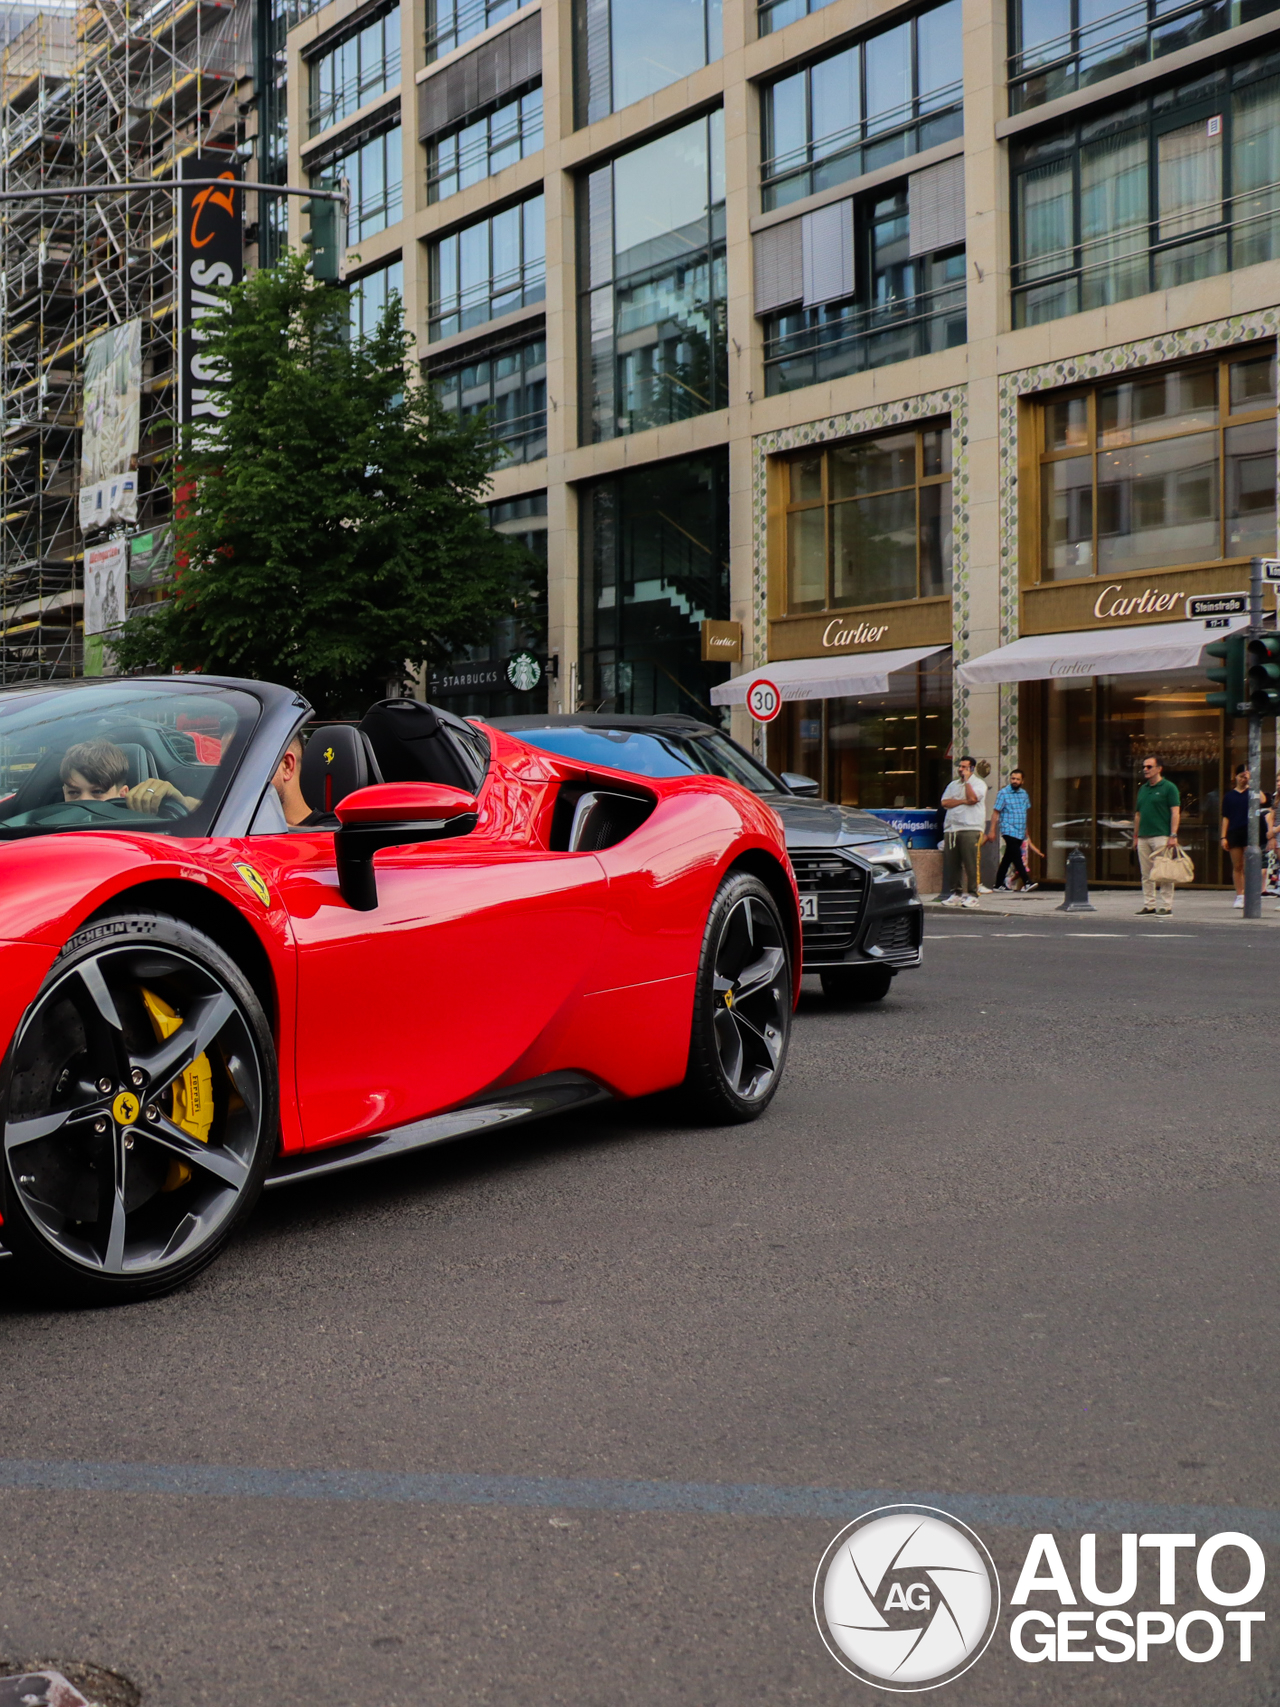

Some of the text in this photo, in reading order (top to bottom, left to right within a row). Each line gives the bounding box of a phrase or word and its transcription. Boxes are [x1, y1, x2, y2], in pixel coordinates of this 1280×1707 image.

[1094, 584, 1185, 619] Cartier
[1194, 599, 1241, 613] Steinstraße
[709, 635, 737, 647] Cartier
[822, 618, 889, 648] Cartier
[1049, 658, 1096, 676] Cartier
[443, 671, 497, 687] STARBUCKS
[780, 685, 813, 699] Cartier
[753, 691, 774, 711] 30
[891, 819, 938, 832] Königsallee
[61, 921, 126, 957] MICHELIN
